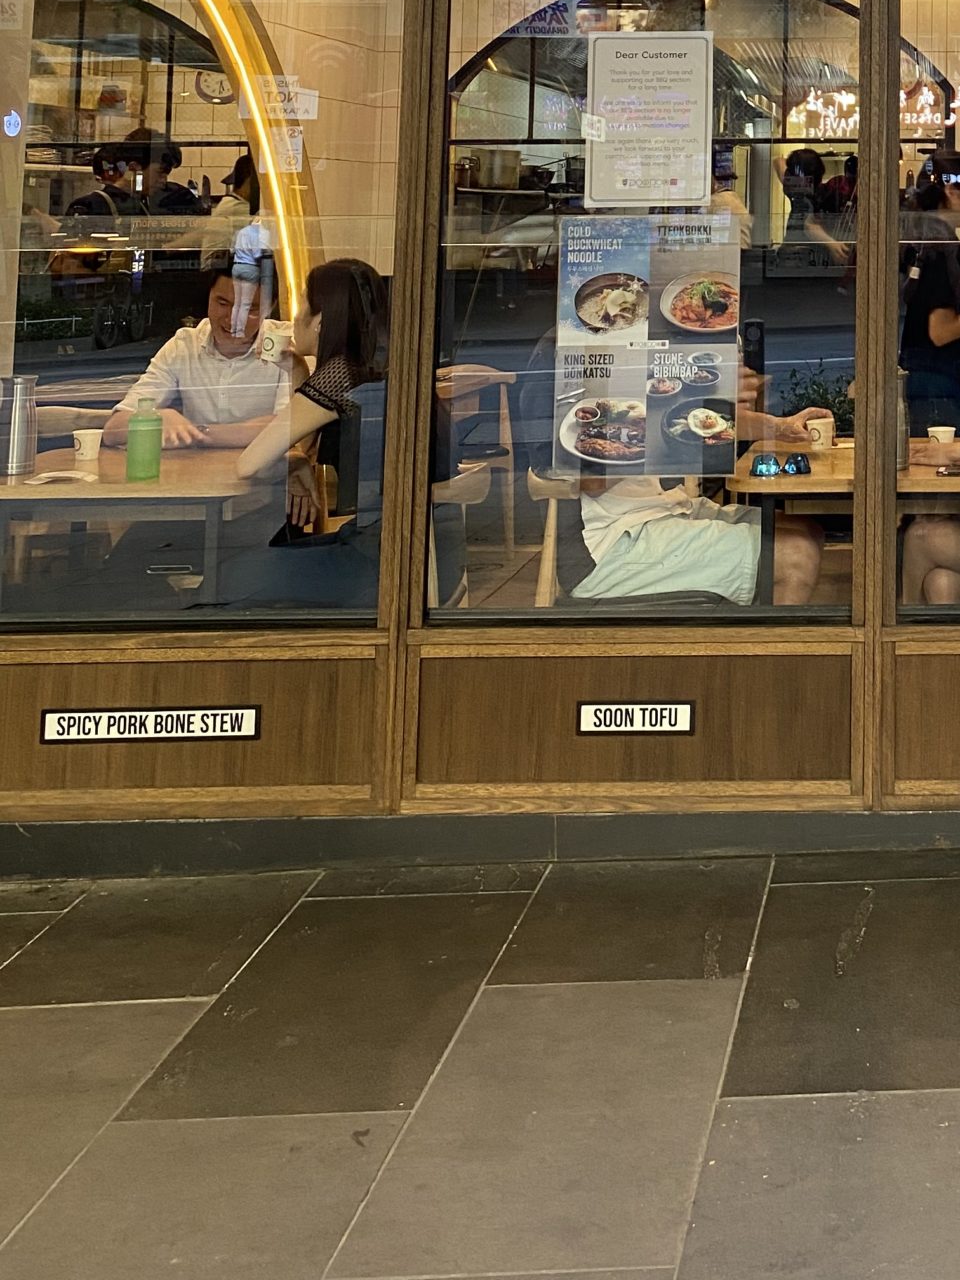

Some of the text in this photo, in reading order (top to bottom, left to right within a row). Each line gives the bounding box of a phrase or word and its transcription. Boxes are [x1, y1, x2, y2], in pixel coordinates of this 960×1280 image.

[615, 51, 688, 59] Dear Customer
[567, 226, 591, 237] COLD
[567, 238, 623, 250] BUCKWHEAT
[567, 251, 603, 263] NOODLE
[564, 353, 614, 366] KING SIZED
[653, 353, 684, 364] STONE
[564, 367, 612, 379] DONKATSU
[653, 366, 699, 378] BIBIMBAP
[593, 707, 678, 728] SOON TOFU
[56, 712, 244, 736] SPICY PORK BONE STEW
